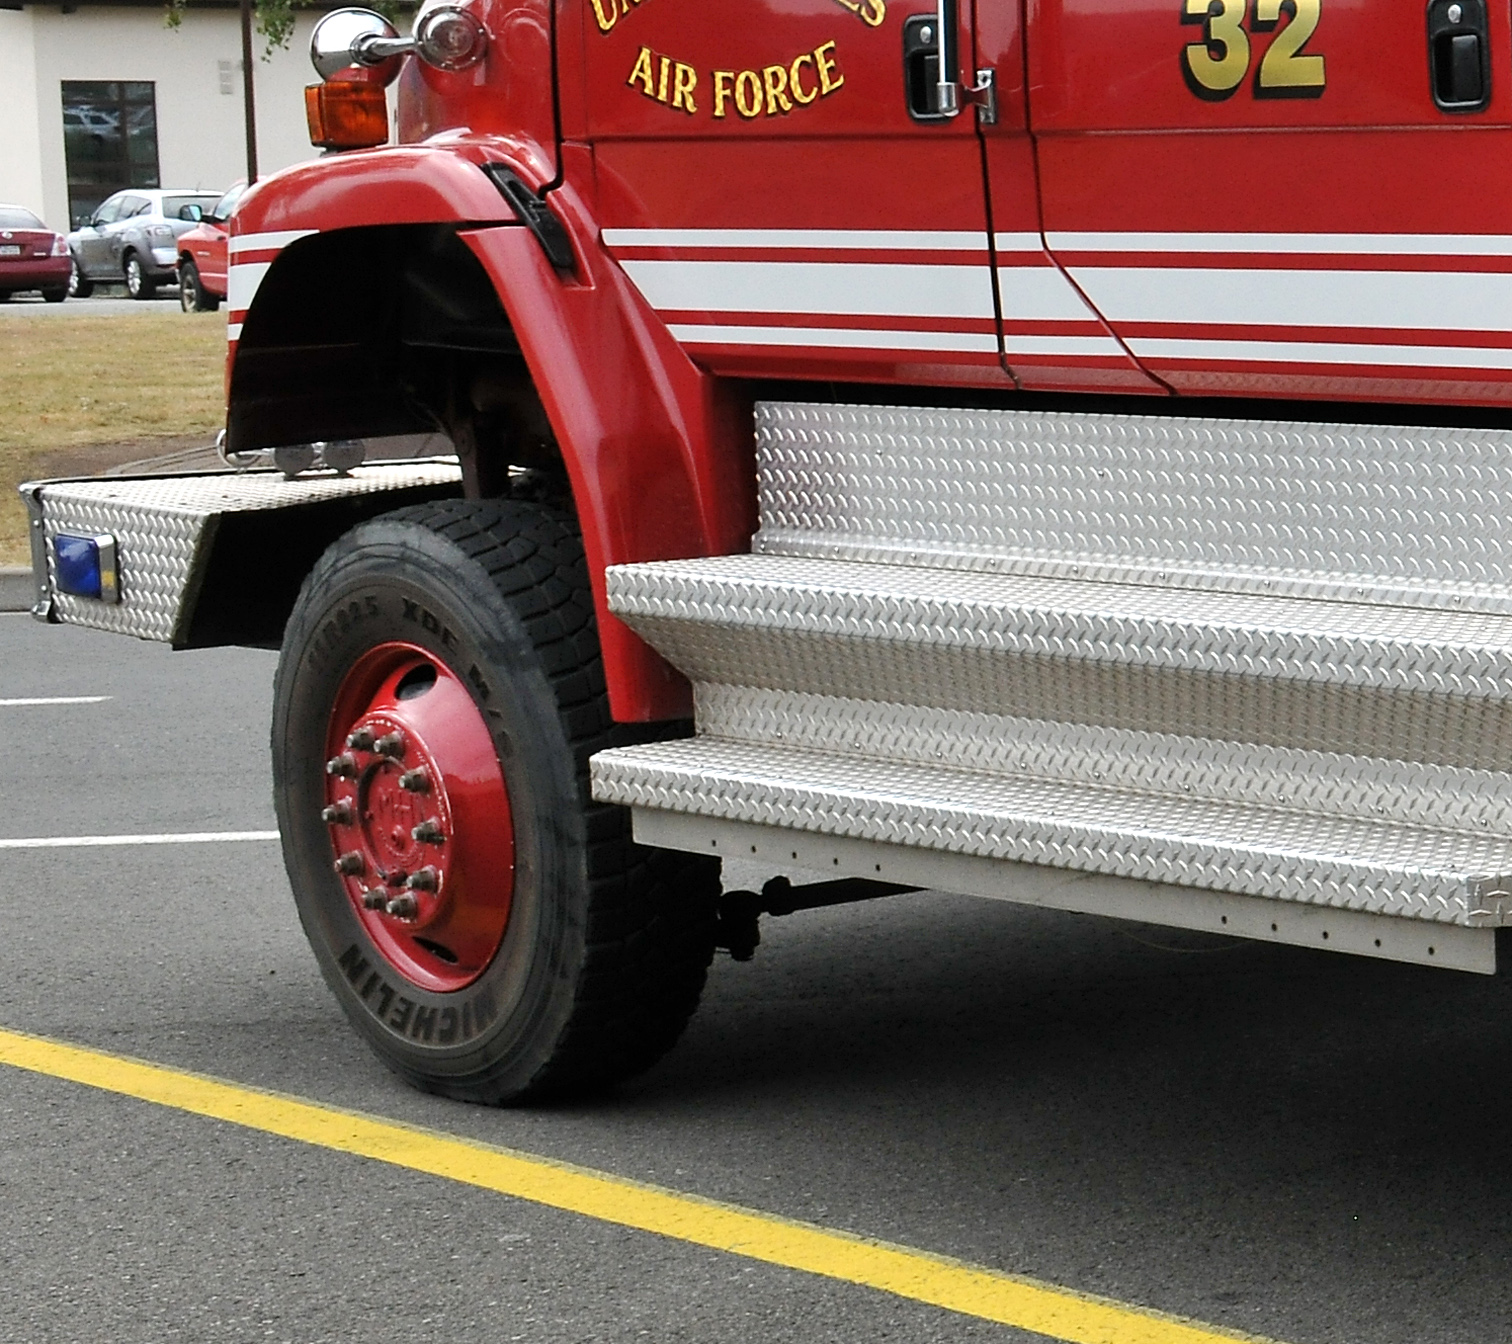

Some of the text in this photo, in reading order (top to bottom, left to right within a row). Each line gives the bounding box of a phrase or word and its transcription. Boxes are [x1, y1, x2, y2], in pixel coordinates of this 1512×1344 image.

[627, 40, 845, 119] AIR FORCE
[401, 595, 460, 654] XDE
[337, 943, 498, 1047] MICHELIN
